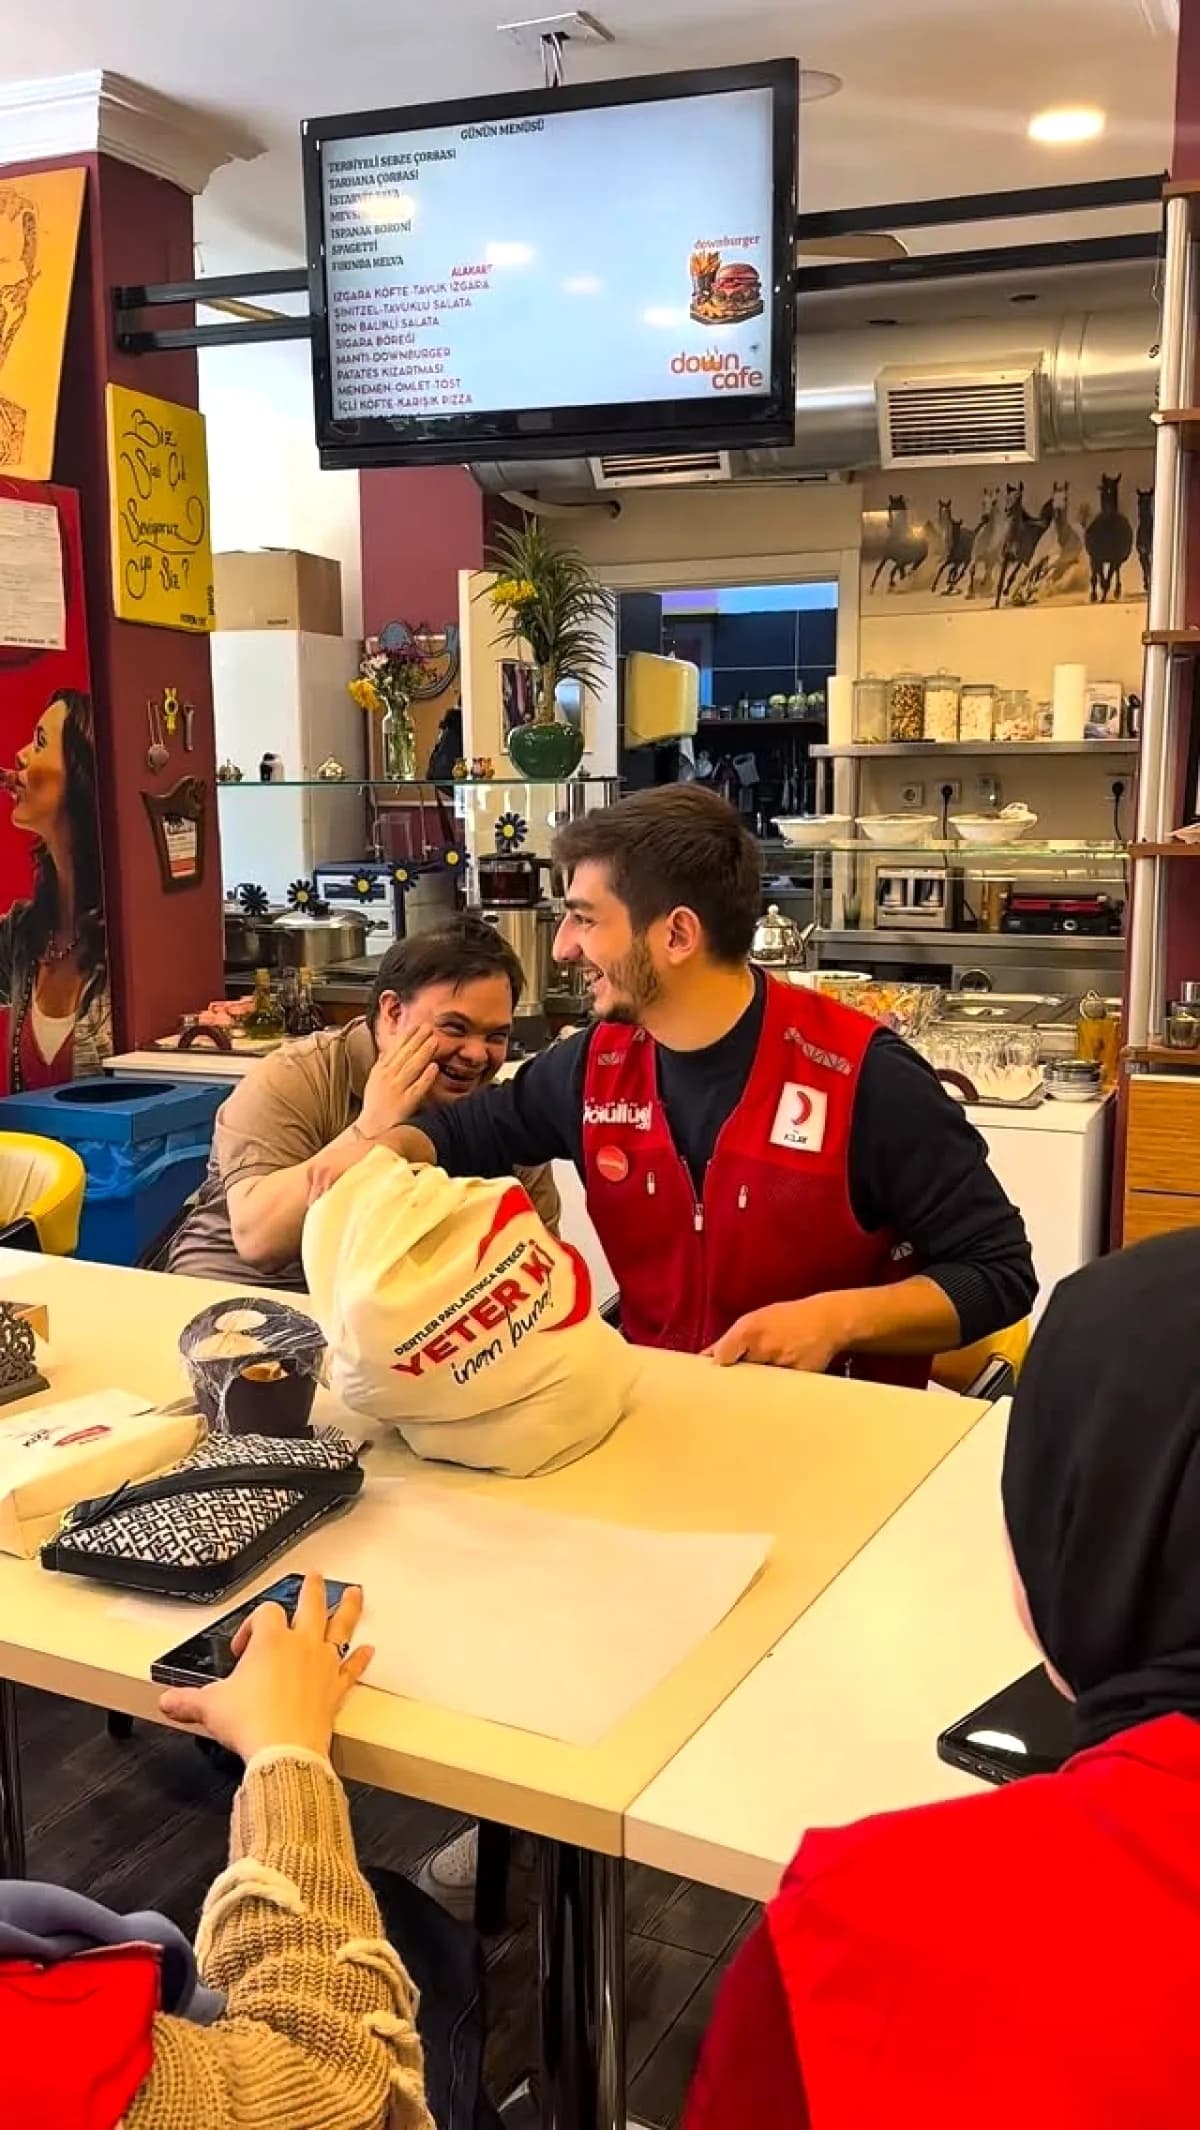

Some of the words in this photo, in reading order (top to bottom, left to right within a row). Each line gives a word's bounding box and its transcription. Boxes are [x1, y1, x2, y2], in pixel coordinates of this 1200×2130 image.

[461, 123, 498, 140] GÜNÜN
[500, 119, 544, 135] MENÜSÜ
[433, 298, 472, 311] SALATA
[336, 322, 357, 333] TON
[401, 316, 440, 329] SALATA
[671, 349, 739, 374] down
[336, 368, 379, 381] PATATES
[712, 366, 762, 389] cafe
[390, 1279, 530, 1376] YETER
[393, 1319, 440, 1356] DERTLER
[451, 1338, 503, 1384] inan
